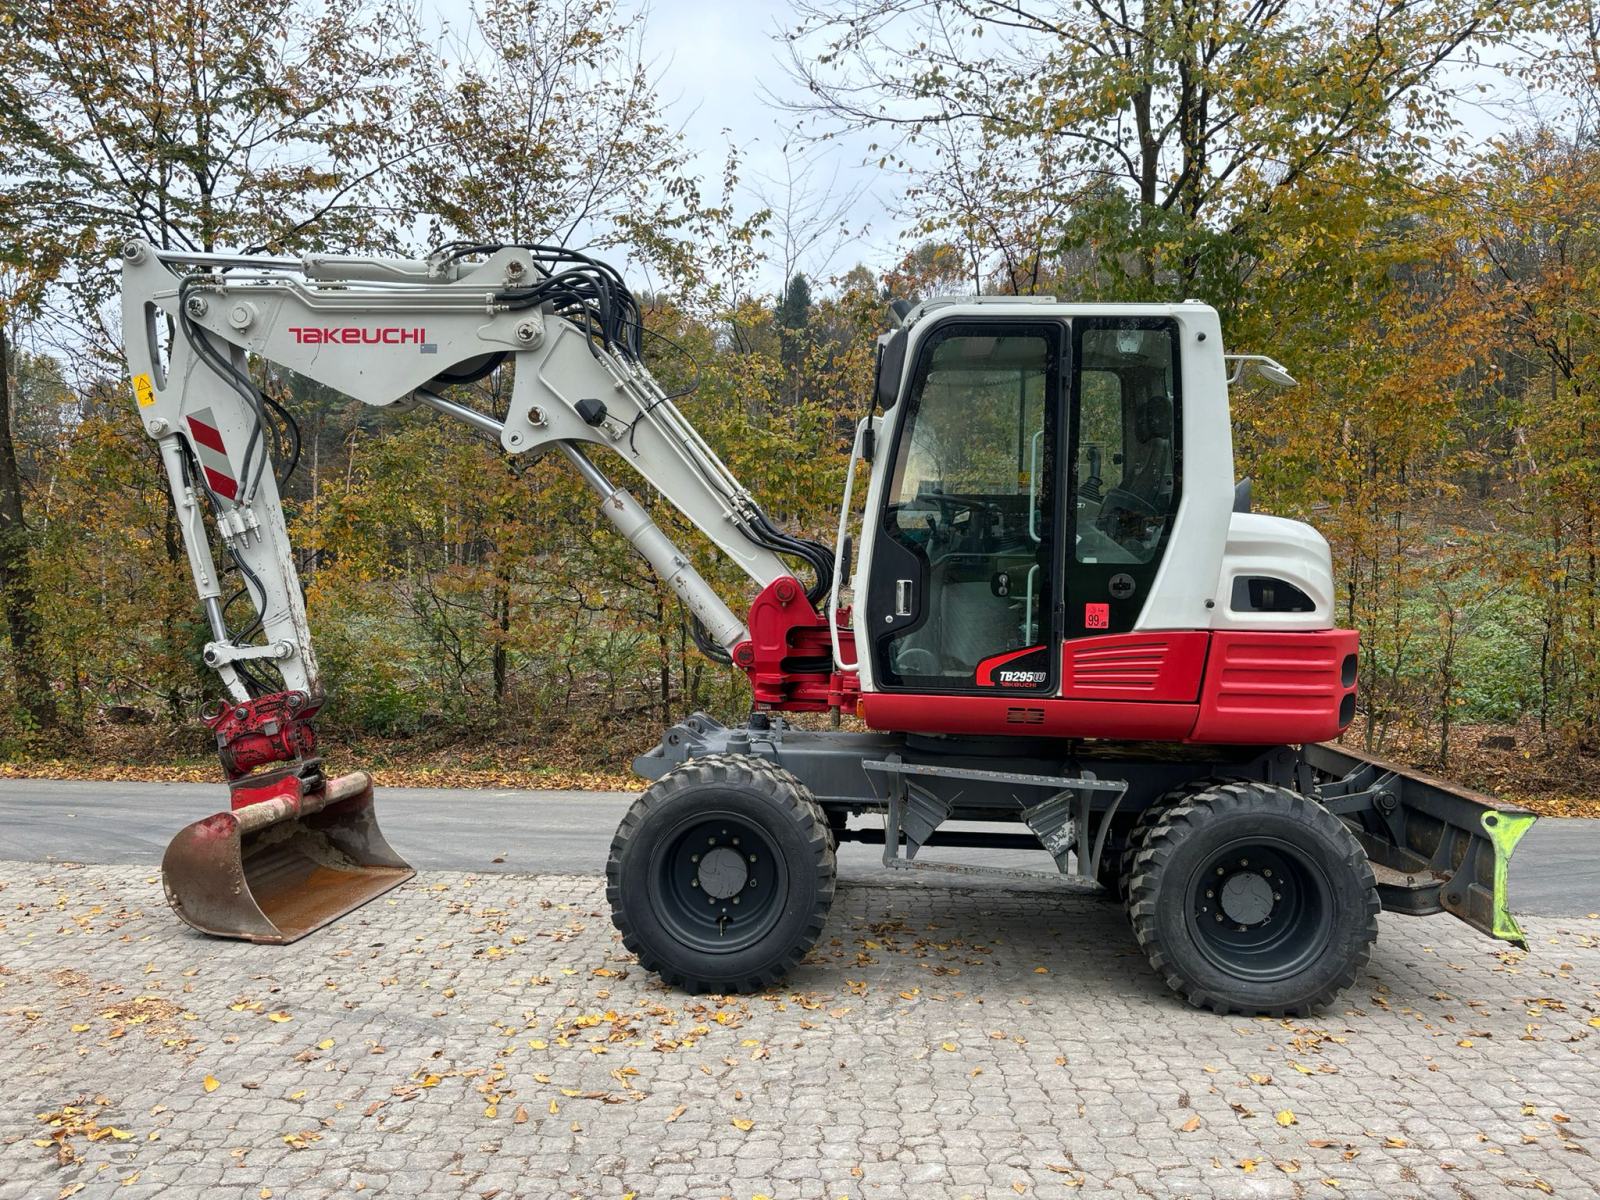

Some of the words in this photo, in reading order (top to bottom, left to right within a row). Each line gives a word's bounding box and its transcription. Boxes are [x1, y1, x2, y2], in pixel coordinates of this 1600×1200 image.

[288, 328, 426, 344] TAKEUCHI
[1088, 614, 1100, 627] 99
[1000, 671, 1047, 682] TB295W
